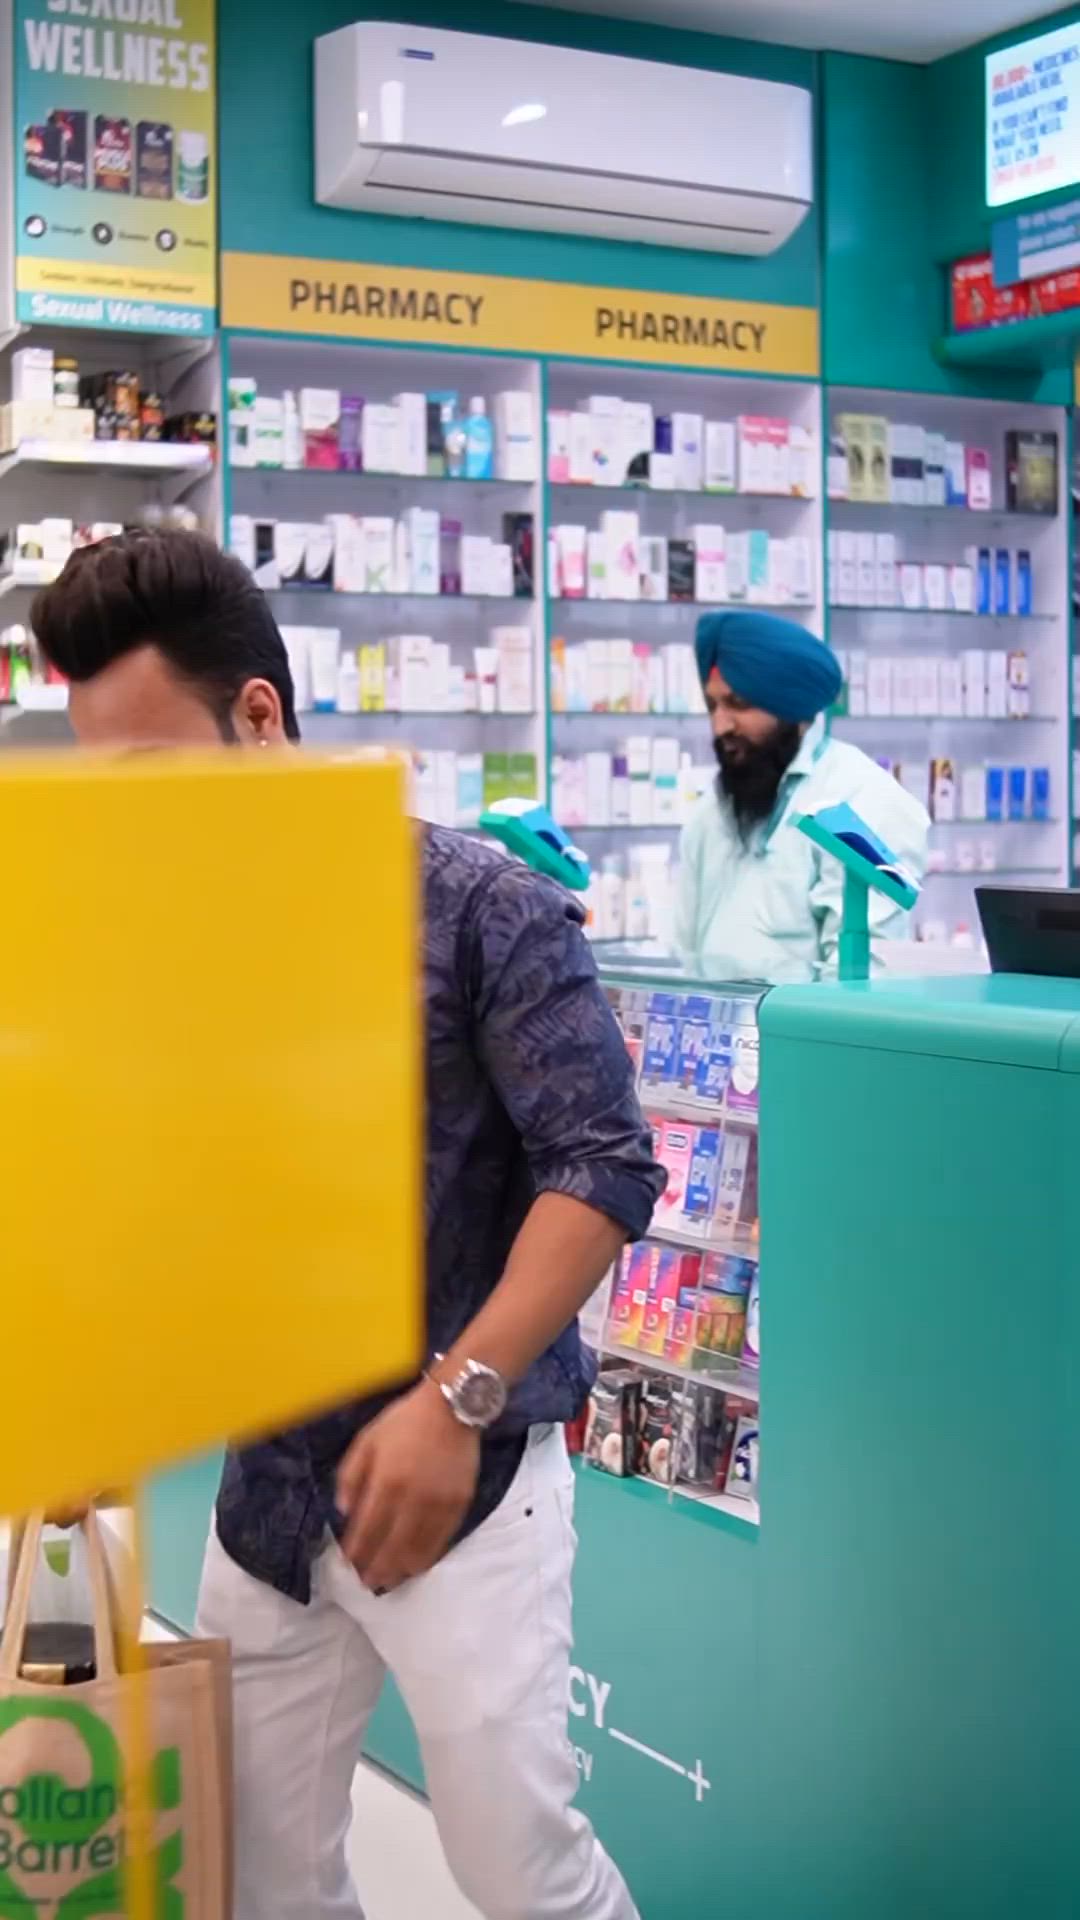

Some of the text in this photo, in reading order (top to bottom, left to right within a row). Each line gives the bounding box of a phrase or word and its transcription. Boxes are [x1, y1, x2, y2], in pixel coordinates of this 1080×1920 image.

[46, 0, 183, 29] UAL
[24, 19, 209, 92] WELLNESS
[31, 292, 204, 330] Sexual Wellness
[289, 278, 767, 354] PHARMACY PHARMACY
[0, 1776, 117, 1822] ollan
